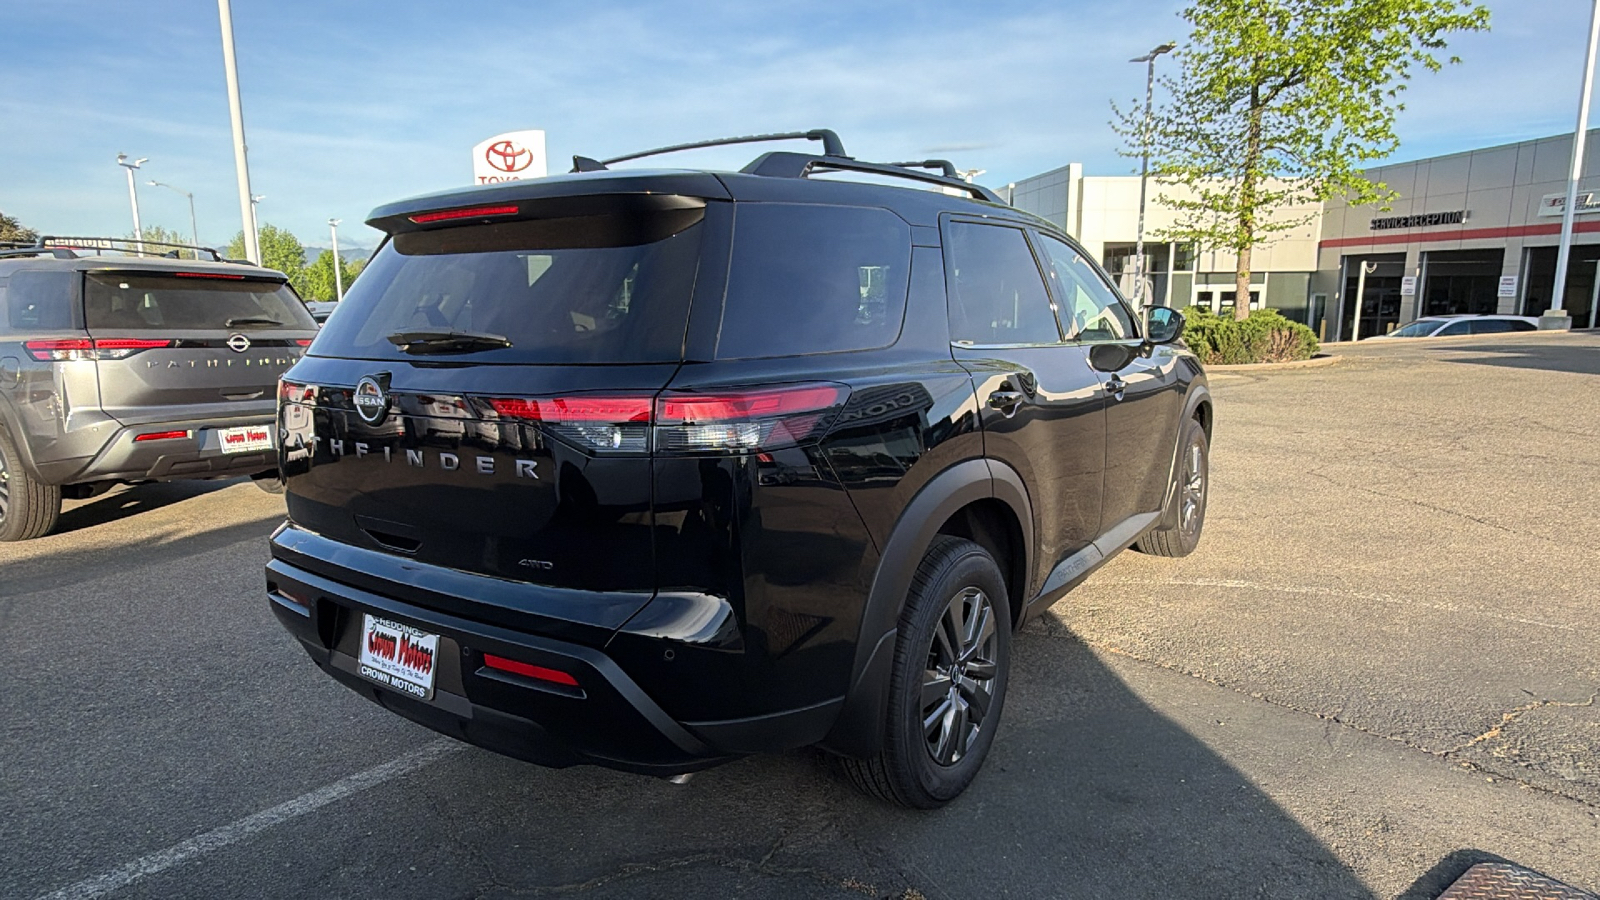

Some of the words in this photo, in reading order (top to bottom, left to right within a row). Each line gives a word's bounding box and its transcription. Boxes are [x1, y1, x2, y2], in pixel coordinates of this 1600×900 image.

[477, 176, 520, 185] TO
[1370, 215, 1407, 230] SERVICE
[1408, 210, 1464, 227] RECEPTION
[354, 396, 385, 406] SSAN
[279, 427, 539, 480] PATHFINDER
[518, 558, 553, 570] 4WD
[367, 630, 397, 662] Crown
[397, 632, 433, 676] Motors
[361, 666, 391, 683] CROWN
[390, 676, 425, 698] MOTORS
